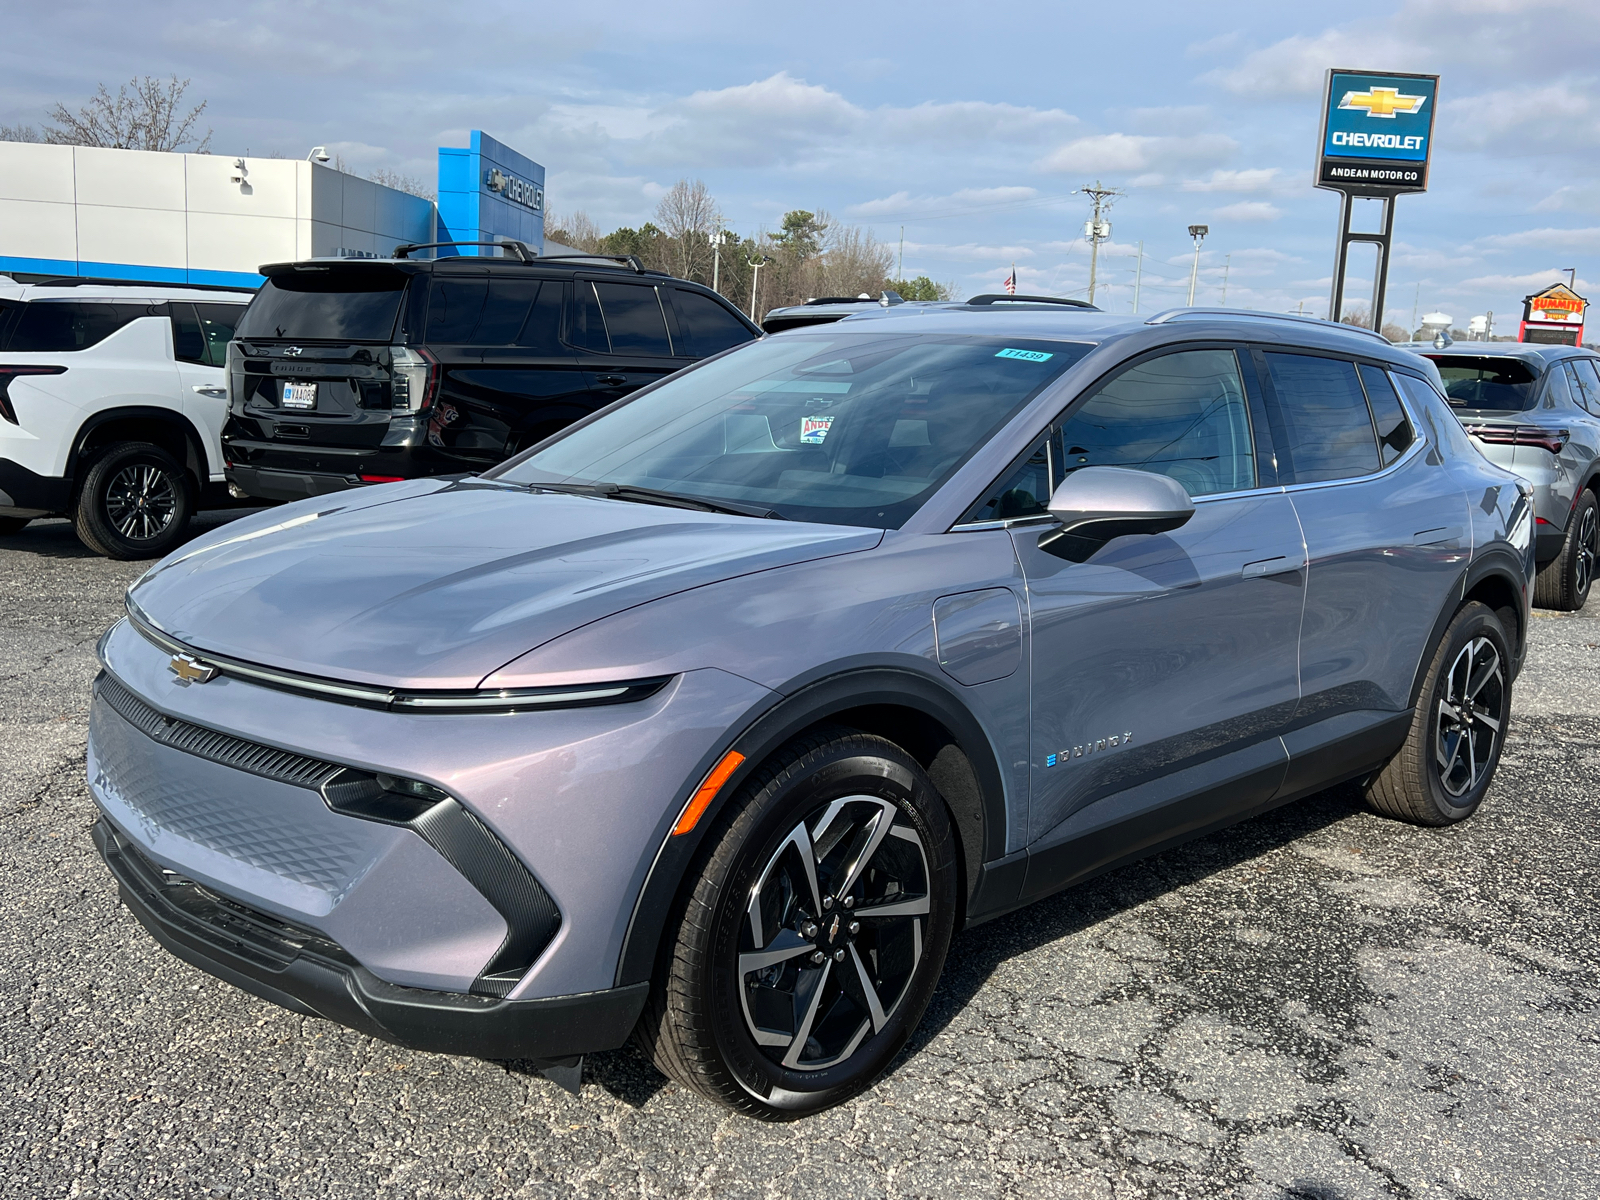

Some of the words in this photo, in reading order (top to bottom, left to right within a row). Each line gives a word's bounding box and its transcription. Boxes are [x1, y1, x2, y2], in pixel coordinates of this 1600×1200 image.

[1331, 131, 1424, 150] CHEVROLET
[1330, 167, 1369, 178] ANDEAN
[1370, 169, 1403, 180] MOTOR
[1404, 171, 1418, 181] CO
[508, 175, 544, 211] CHEVROLET
[1533, 298, 1583, 313] SUMMITS
[1005, 349, 1044, 360] T1439
[1045, 730, 1132, 768] EQUINOX
